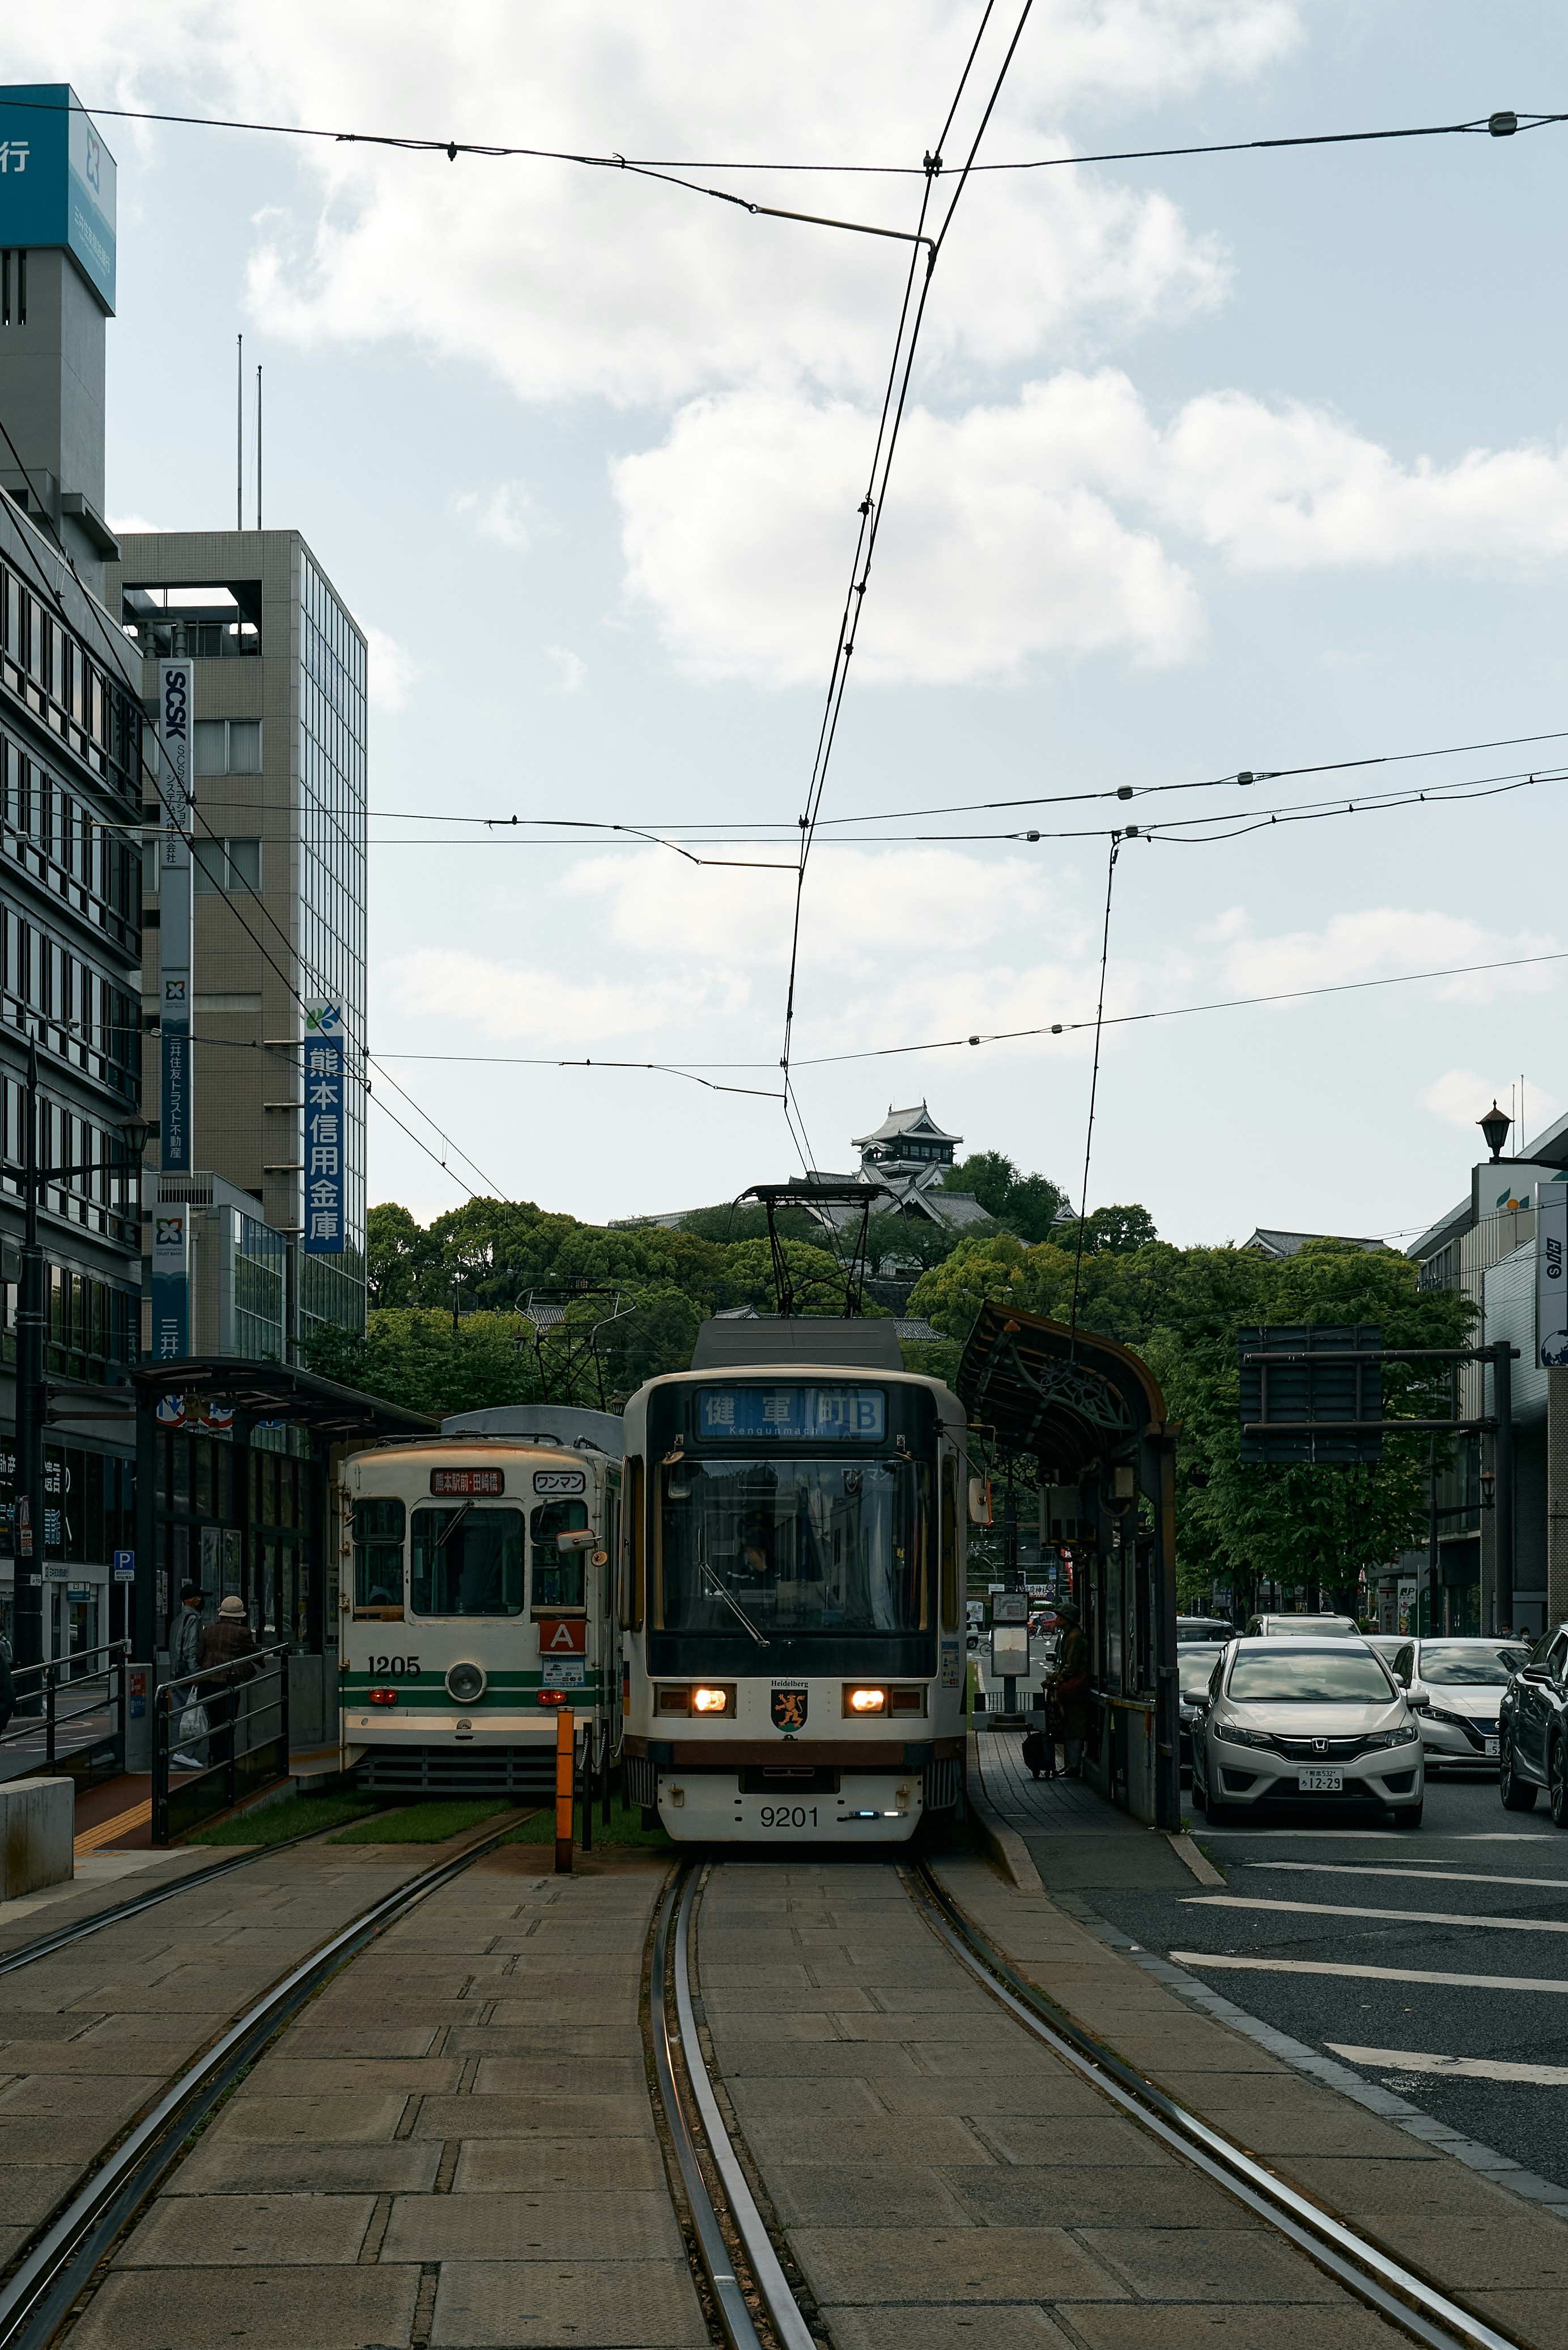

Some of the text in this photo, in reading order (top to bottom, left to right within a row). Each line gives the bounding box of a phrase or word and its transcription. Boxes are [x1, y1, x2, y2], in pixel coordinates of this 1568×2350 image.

[166, 670, 186, 741] SCSK
[169, 1037, 182, 1159] 三井住友トラスト不動産
[309, 1048, 339, 1241] 熊本信用金庫
[160, 1319, 179, 1359] 三井
[729, 1426, 824, 1435] Kengunmachi
[537, 1476, 583, 1489] ワンマン
[120, 1553, 130, 1568] P
[550, 1624, 574, 1648] A
[368, 1656, 420, 1677] 1205
[1310, 1778, 1340, 1788] 12-29
[760, 1807, 817, 1828] 9201
